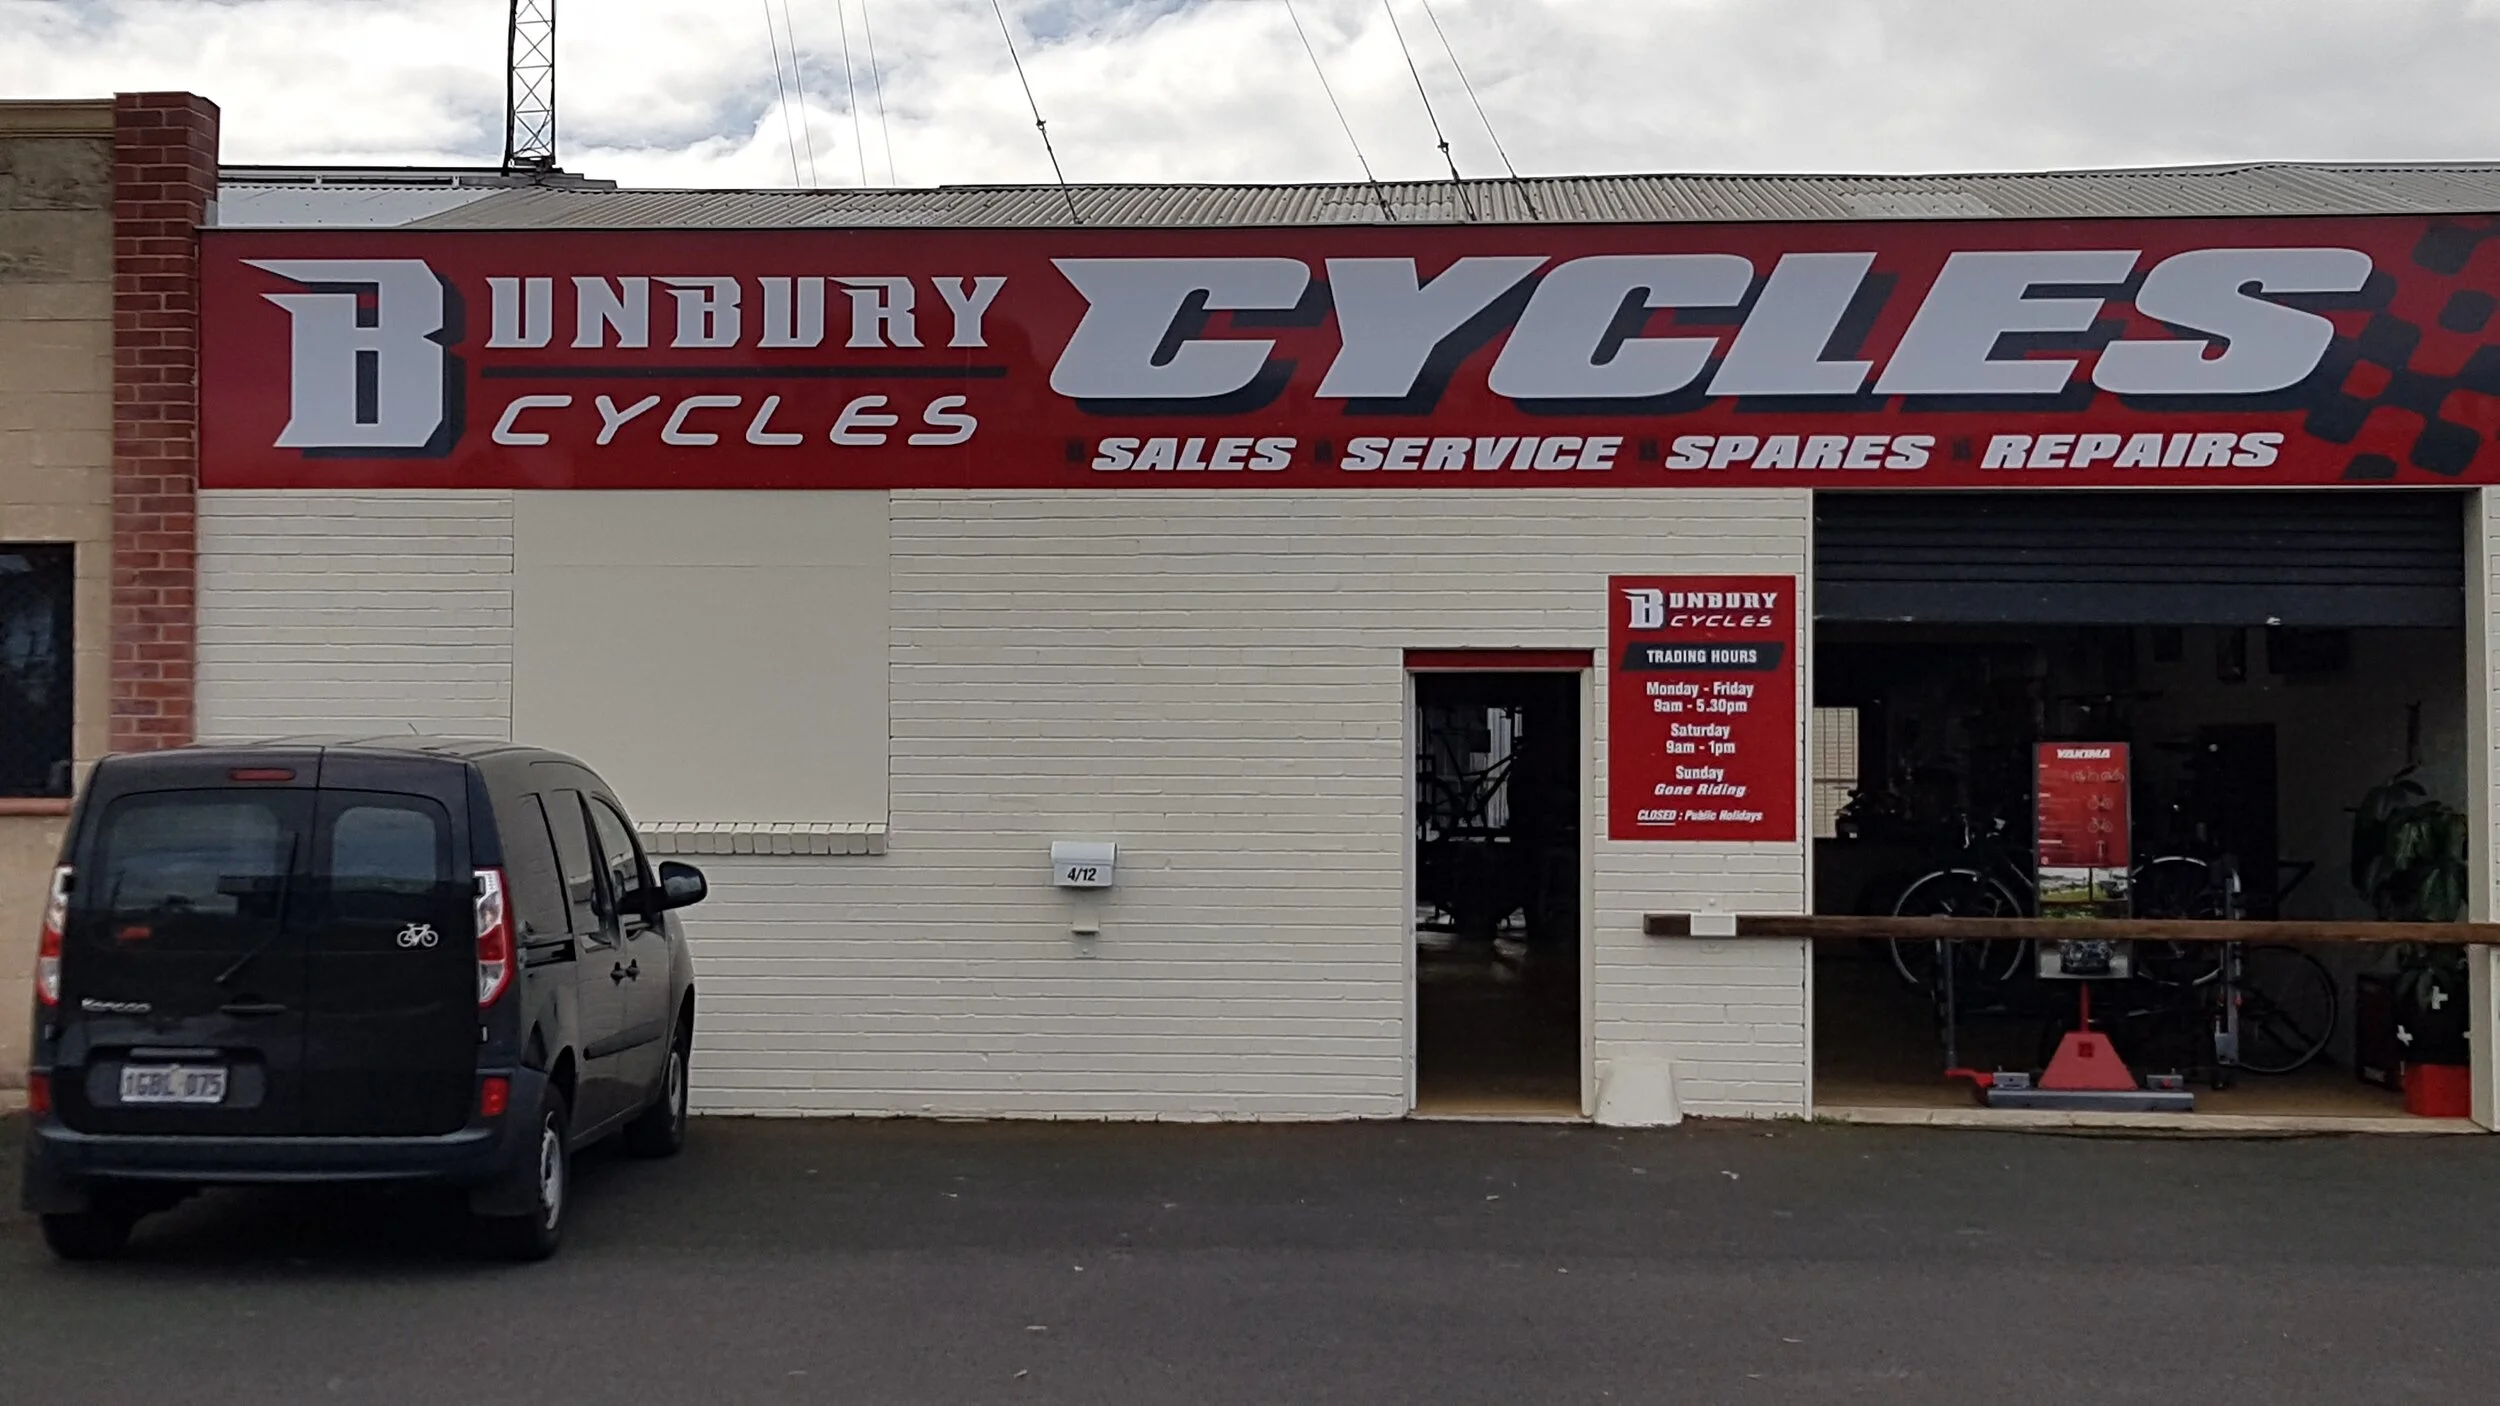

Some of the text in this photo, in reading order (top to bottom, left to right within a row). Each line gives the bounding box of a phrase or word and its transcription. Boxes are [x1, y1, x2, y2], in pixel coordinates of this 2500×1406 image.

[1049, 247, 2373, 399] CYCLES
[239, 259, 1008, 448] BUNBURY
[491, 395, 979, 446] CYCLES
[1092, 432, 2285, 471] SALES SERVICE SPARES REPAIRS
[1620, 588, 1778, 629] BUNBURY
[1670, 615, 1772, 627] CYCLES
[1647, 650, 1757, 663] TRADING HOURS
[1646, 682, 1699, 698] Monday
[1713, 682, 1754, 698] Friday
[1654, 699, 1683, 712] 9am
[1696, 699, 1748, 715] 5.30pm
[1671, 723, 1730, 740] Saturday
[1666, 740, 1695, 753] 9am
[1708, 740, 1736, 756] 1pm
[2057, 749, 2111, 758] YAKIMA
[1675, 766, 1724, 782] Sunday
[1654, 784, 1747, 798] Gone Riding
[1637, 810, 1676, 820] CLOSED
[1684, 810, 1716, 820] Public
[1719, 810, 1763, 823] Holidays
[1067, 867, 1097, 882] 4/12
